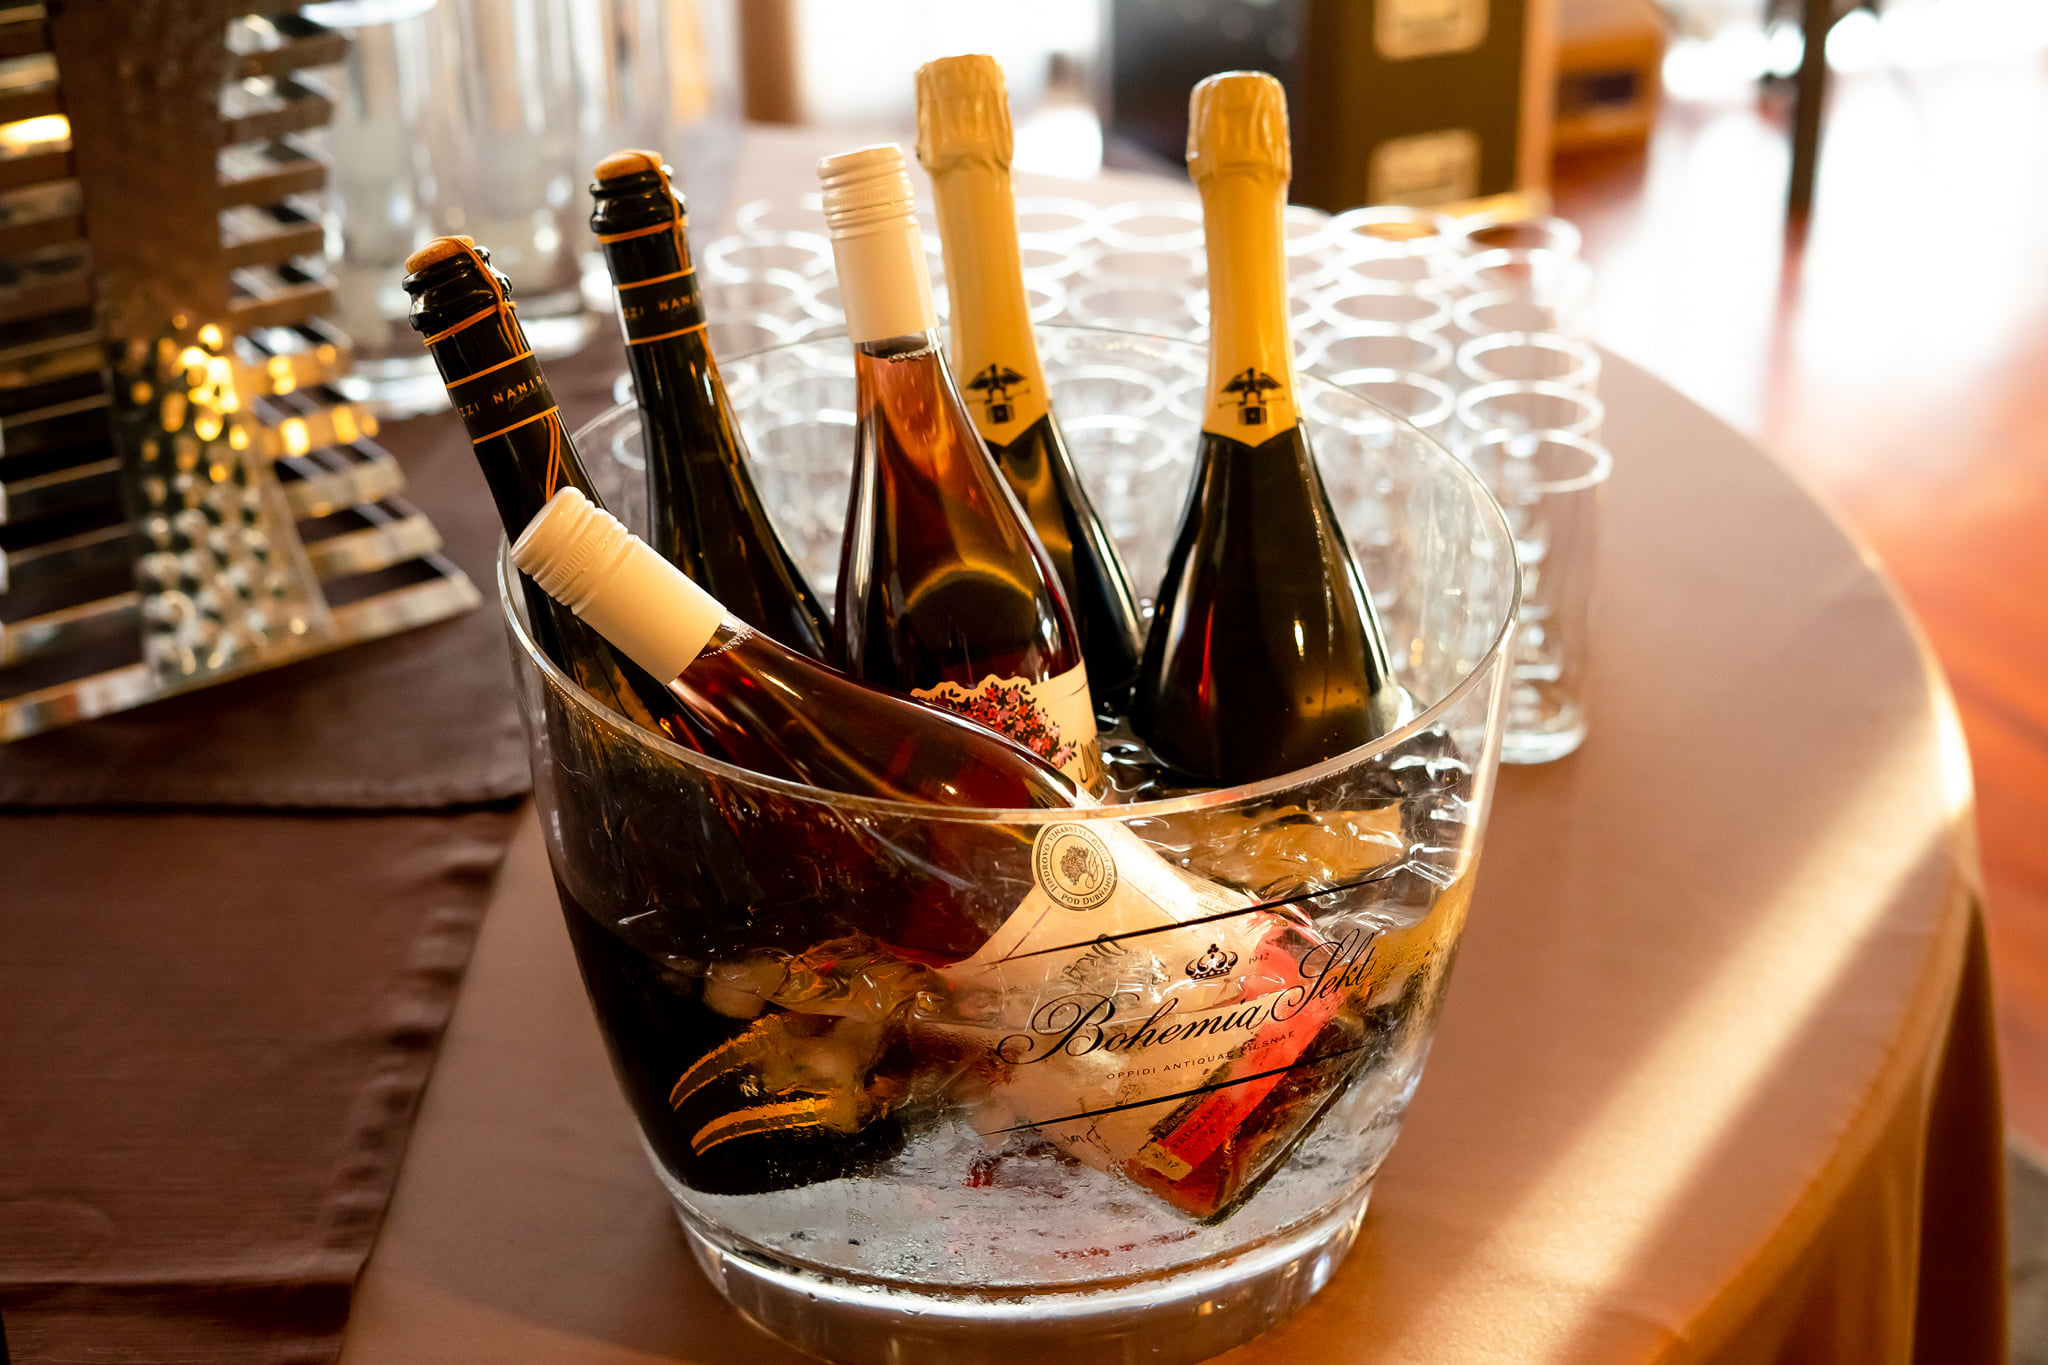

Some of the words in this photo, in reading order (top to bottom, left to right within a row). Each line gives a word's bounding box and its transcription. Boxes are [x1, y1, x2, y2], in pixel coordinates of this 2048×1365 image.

[1060, 893, 1080, 906] POD
[997, 992, 1271, 1065] Bohemia
[1270, 928, 1376, 1022] Sekt
[1106, 1066, 1156, 1080] OPPIDI
[1163, 1050, 1234, 1072] ANTIQUAE
